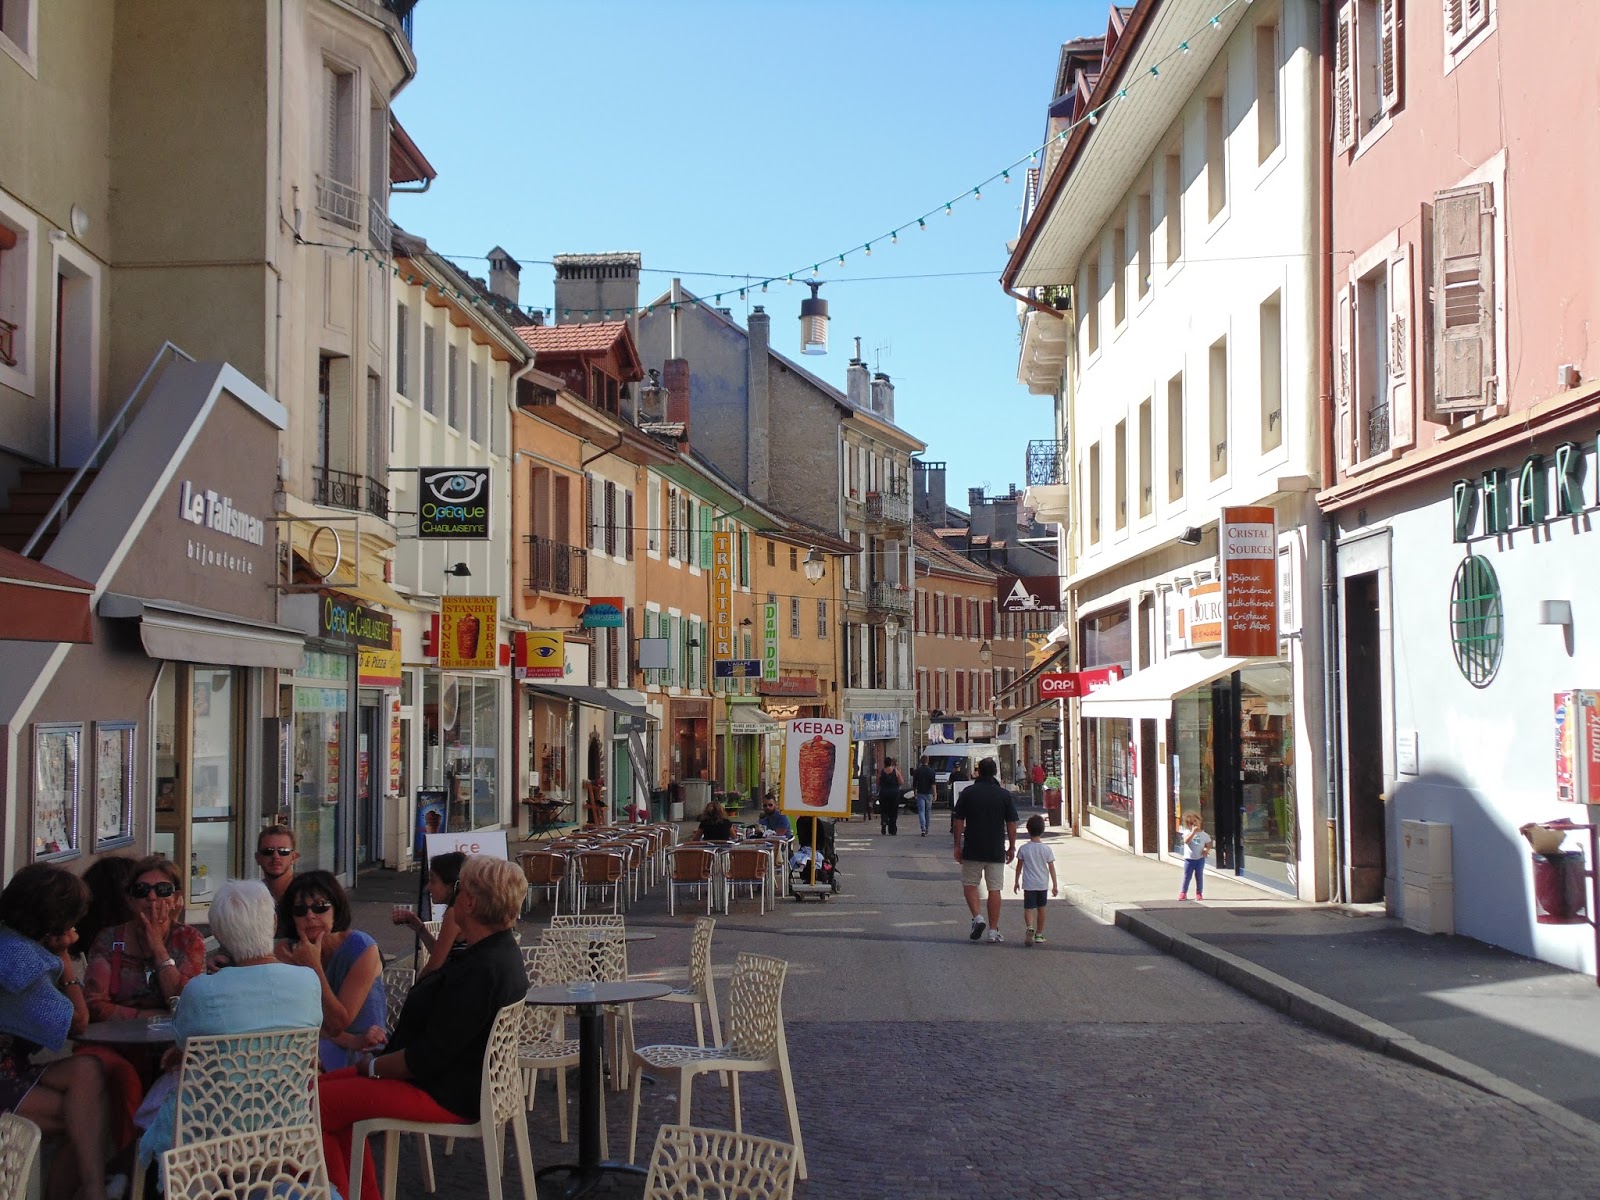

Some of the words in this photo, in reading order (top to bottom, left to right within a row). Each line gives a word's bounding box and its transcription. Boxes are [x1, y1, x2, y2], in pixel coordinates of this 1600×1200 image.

[1452, 429, 1600, 543] PHAR
[181, 480, 204, 525] Le
[205, 489, 264, 546] Talisman
[422, 503, 485, 521] Optique
[1228, 527, 1270, 539] CRISTAL
[1228, 543, 1273, 555] SOURCES
[187, 539, 252, 575] bijouterie
[1232, 572, 1260, 584] Bijoux
[716, 537, 730, 655] TRAITEUR
[1232, 586, 1272, 595] Minéraux
[442, 596, 495, 604] RESTAURANT
[1232, 599, 1275, 611] Lithothérapie
[442, 604, 494, 613] ISTANBUL
[1232, 610, 1268, 621] Cristaux
[1232, 622, 1247, 630] des
[1249, 621, 1272, 632] Alpes
[484, 614, 496, 659] KEBAB
[1042, 679, 1075, 691] ORPI
[793, 721, 844, 735] KEBAB
[455, 840, 480, 854] ice
